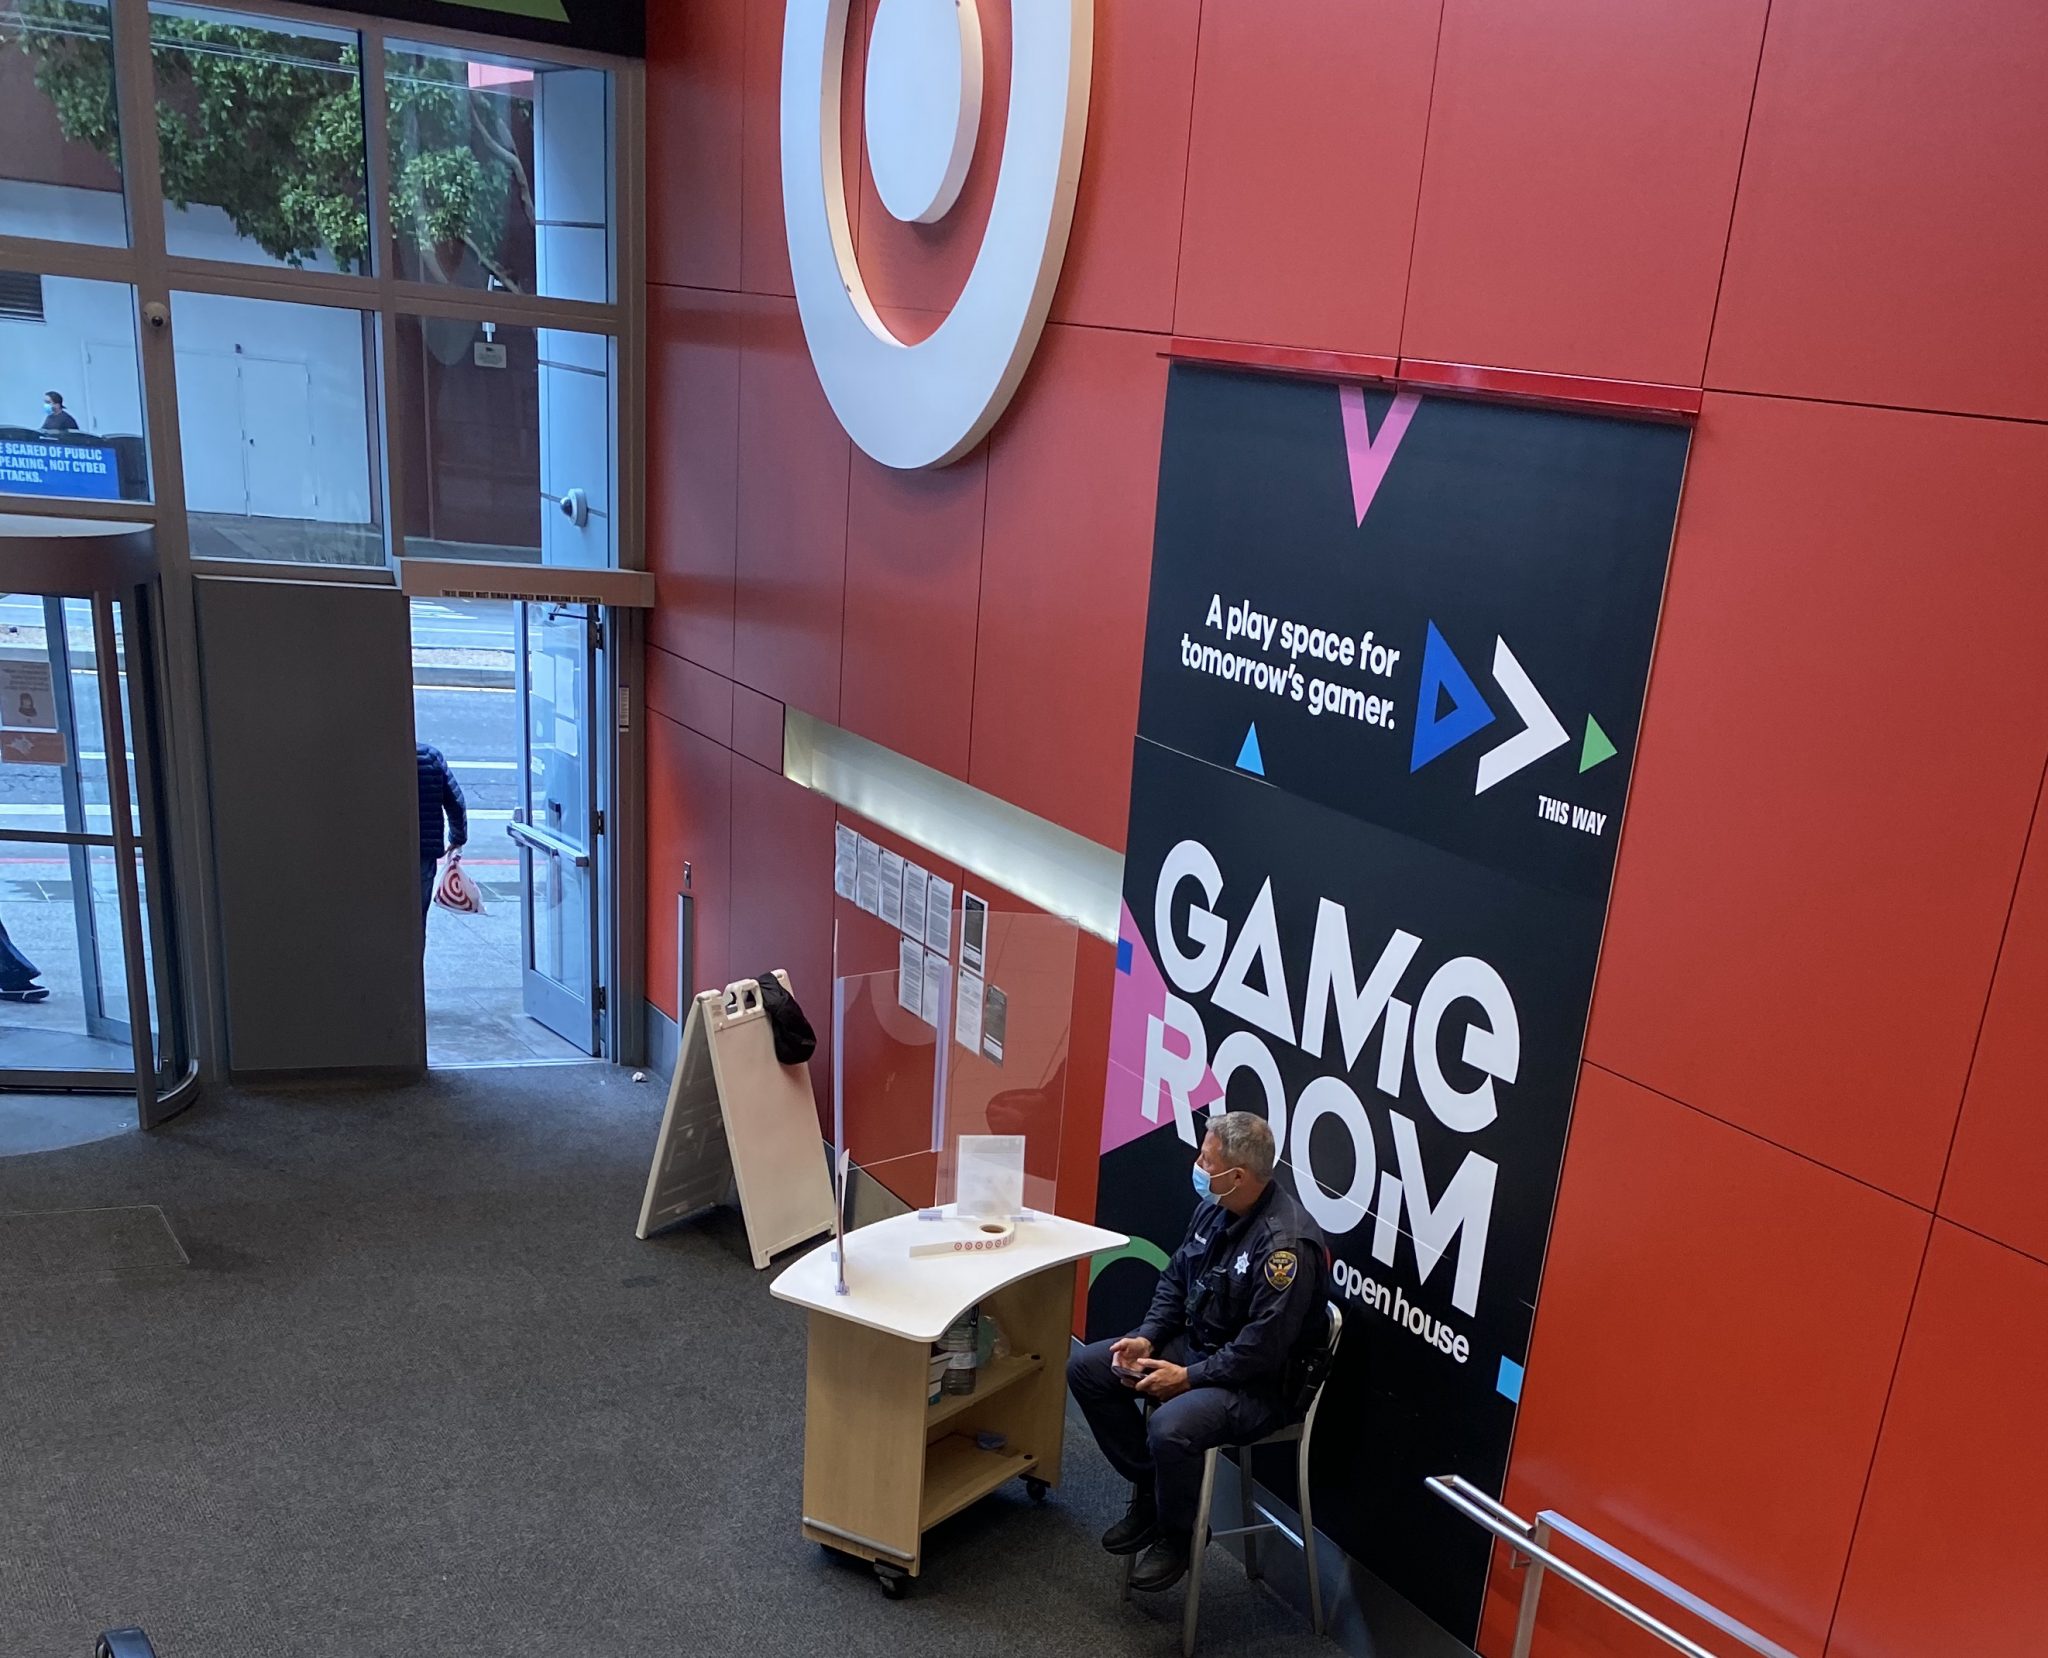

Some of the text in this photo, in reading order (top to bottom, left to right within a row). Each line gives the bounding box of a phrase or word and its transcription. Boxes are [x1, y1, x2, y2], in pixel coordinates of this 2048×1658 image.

[5, 443, 47, 457] SCARED
[49, 446, 62, 458] OF
[64, 447, 102, 461] PUBLIC
[49, 460, 70, 472] NOT
[73, 461, 107, 474] CYBER
[1205, 593, 1401, 678] A play space for
[1180, 632, 1396, 730] tomorrow's gamer.
[1538, 794, 1608, 836] THIS WAY
[1140, 990, 1499, 1318] ROOM
[1332, 1258, 1470, 1364] open house
